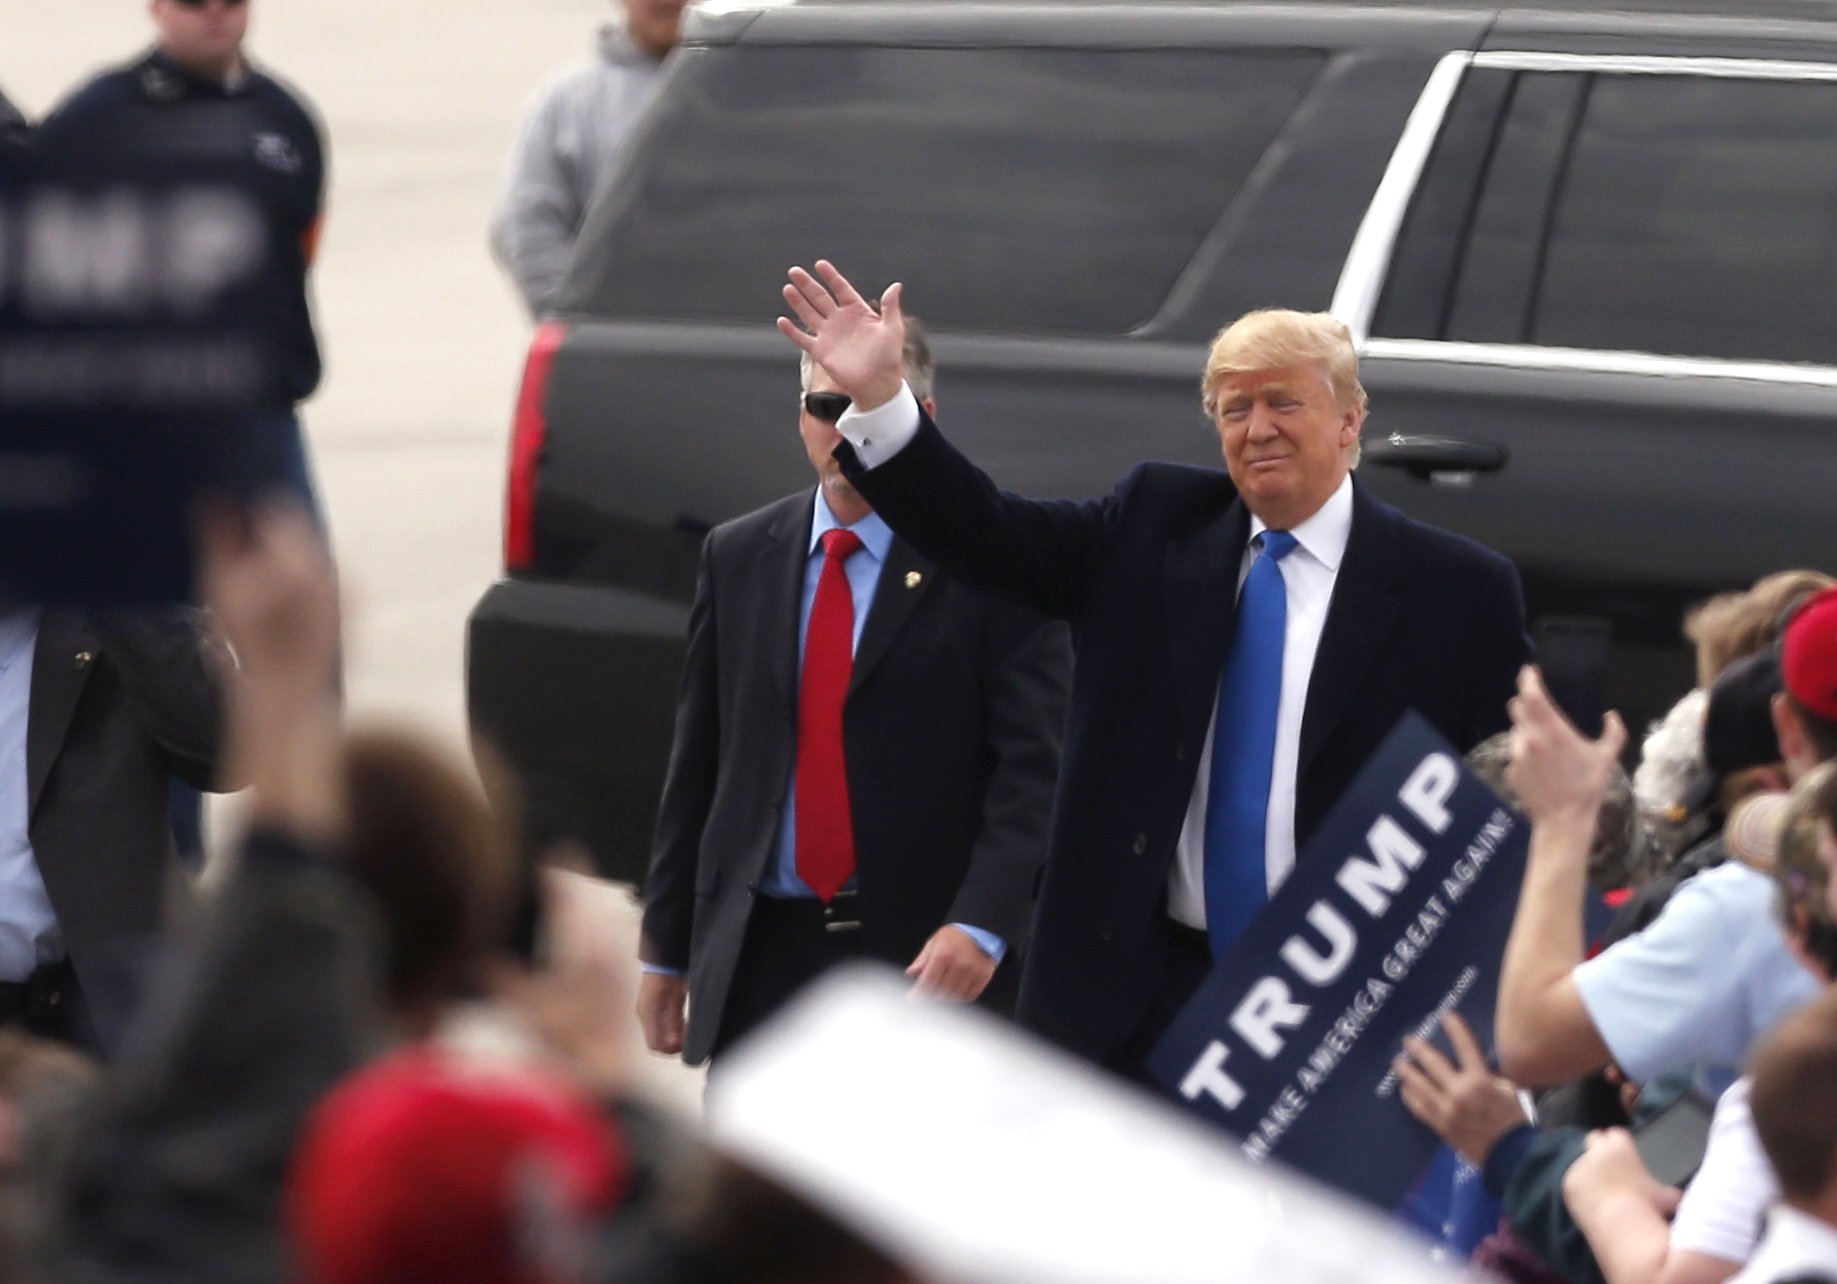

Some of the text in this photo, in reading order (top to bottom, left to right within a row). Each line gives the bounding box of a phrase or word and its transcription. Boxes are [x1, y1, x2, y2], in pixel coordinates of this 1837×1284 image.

[1180, 752, 1461, 1112] TRUMP
[1241, 1084, 1310, 1162] MAKE
[1296, 977, 1396, 1094] AMERICA
[1382, 896, 1451, 982] GREAT
